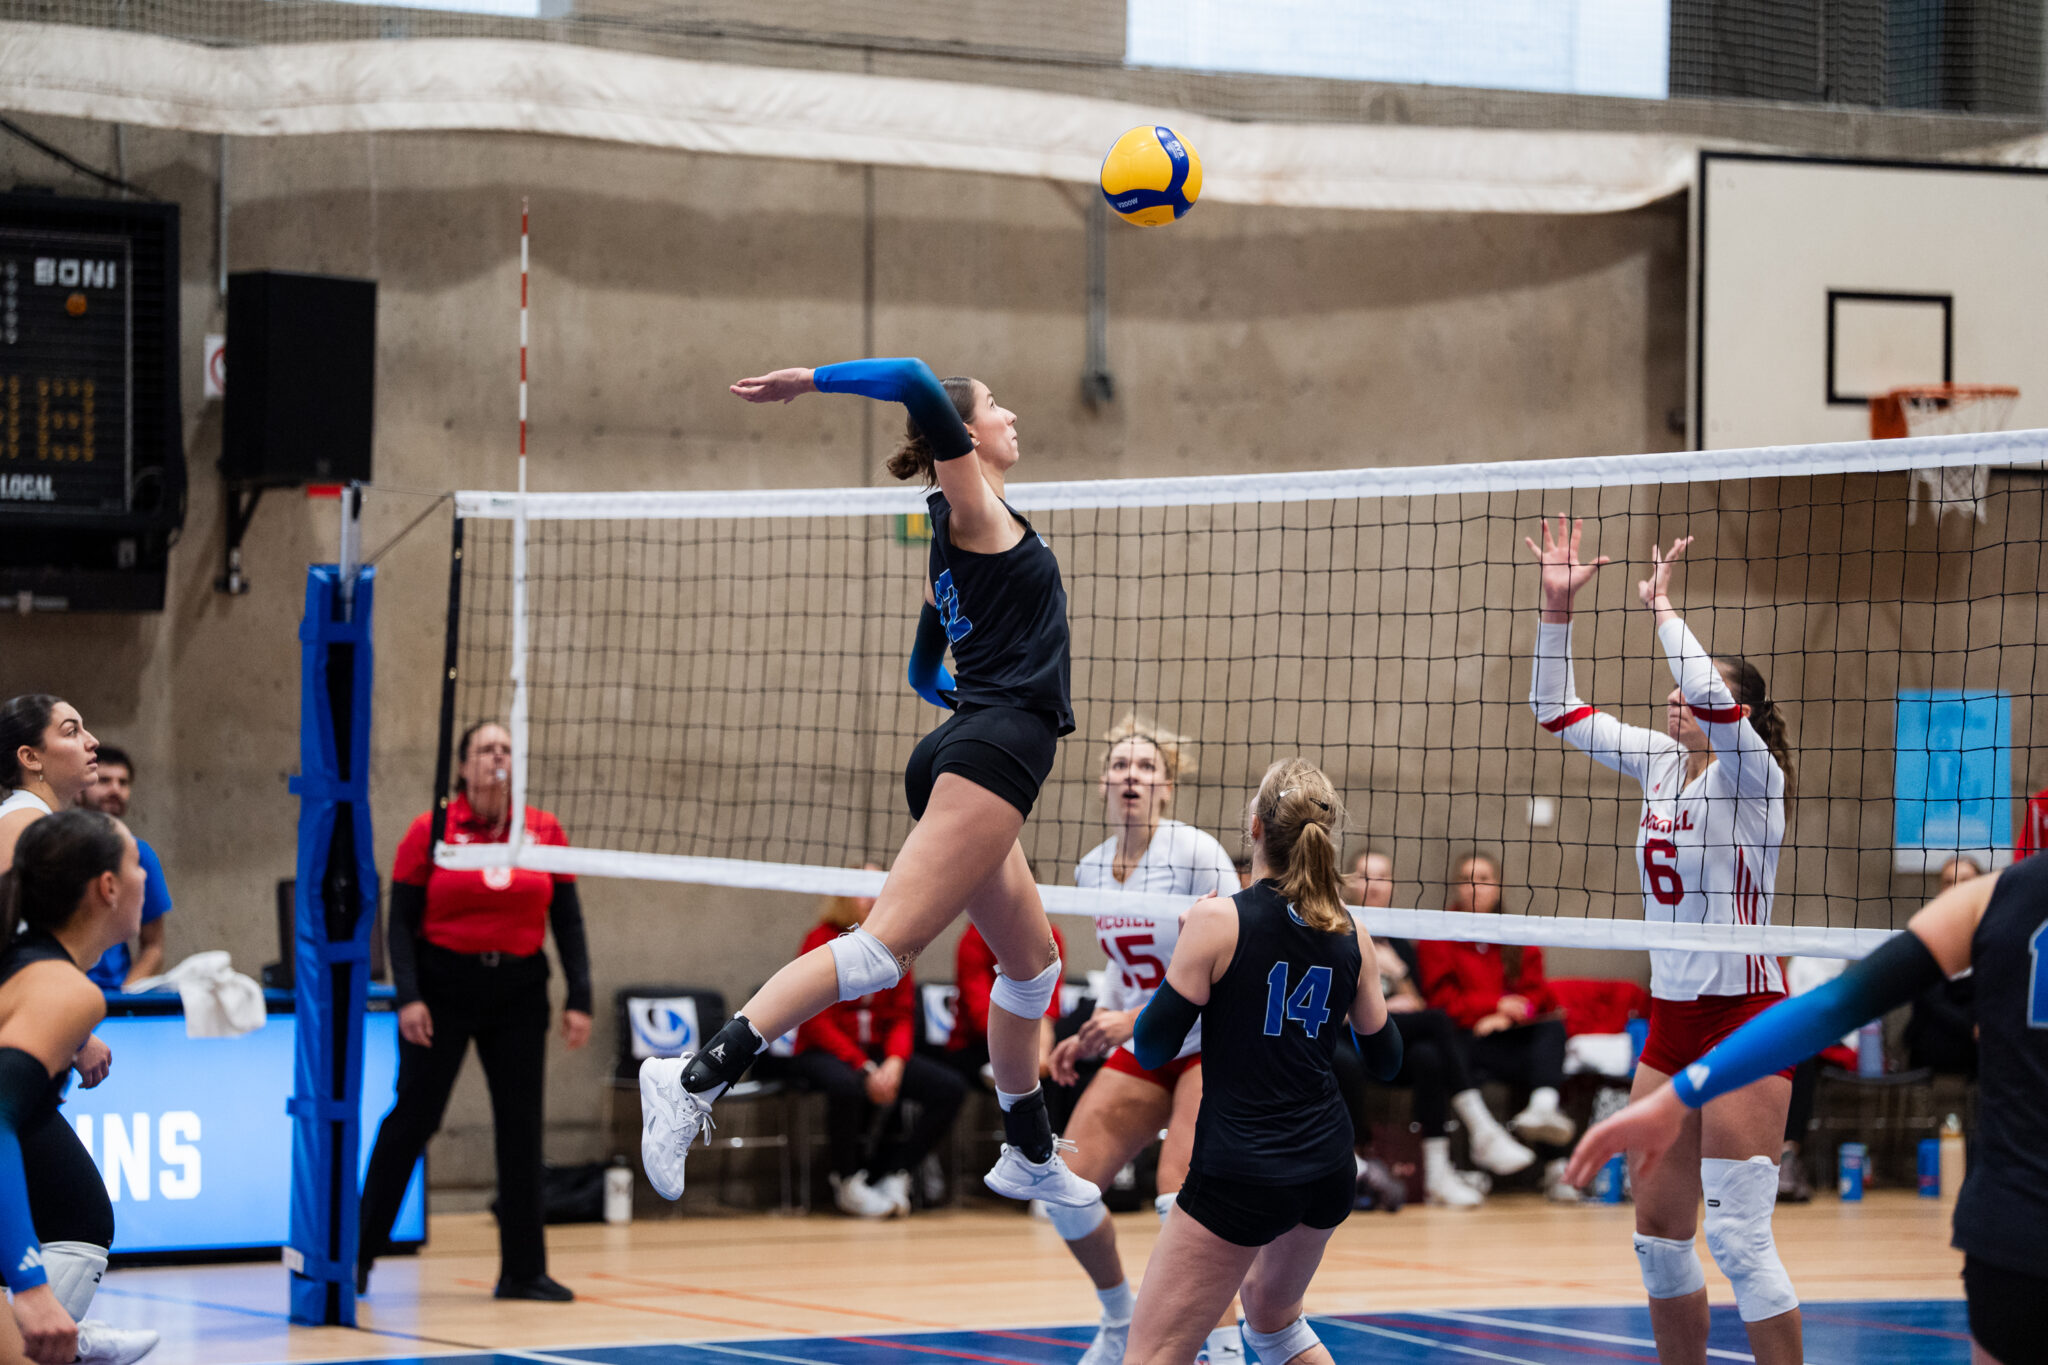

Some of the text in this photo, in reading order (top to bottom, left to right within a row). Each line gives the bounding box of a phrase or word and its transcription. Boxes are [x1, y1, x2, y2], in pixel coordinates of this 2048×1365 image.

[33, 257, 117, 289] BONI
[1643, 838, 1685, 906] 6
[1100, 934, 1166, 990] 15
[1263, 961, 1333, 1039] 14
